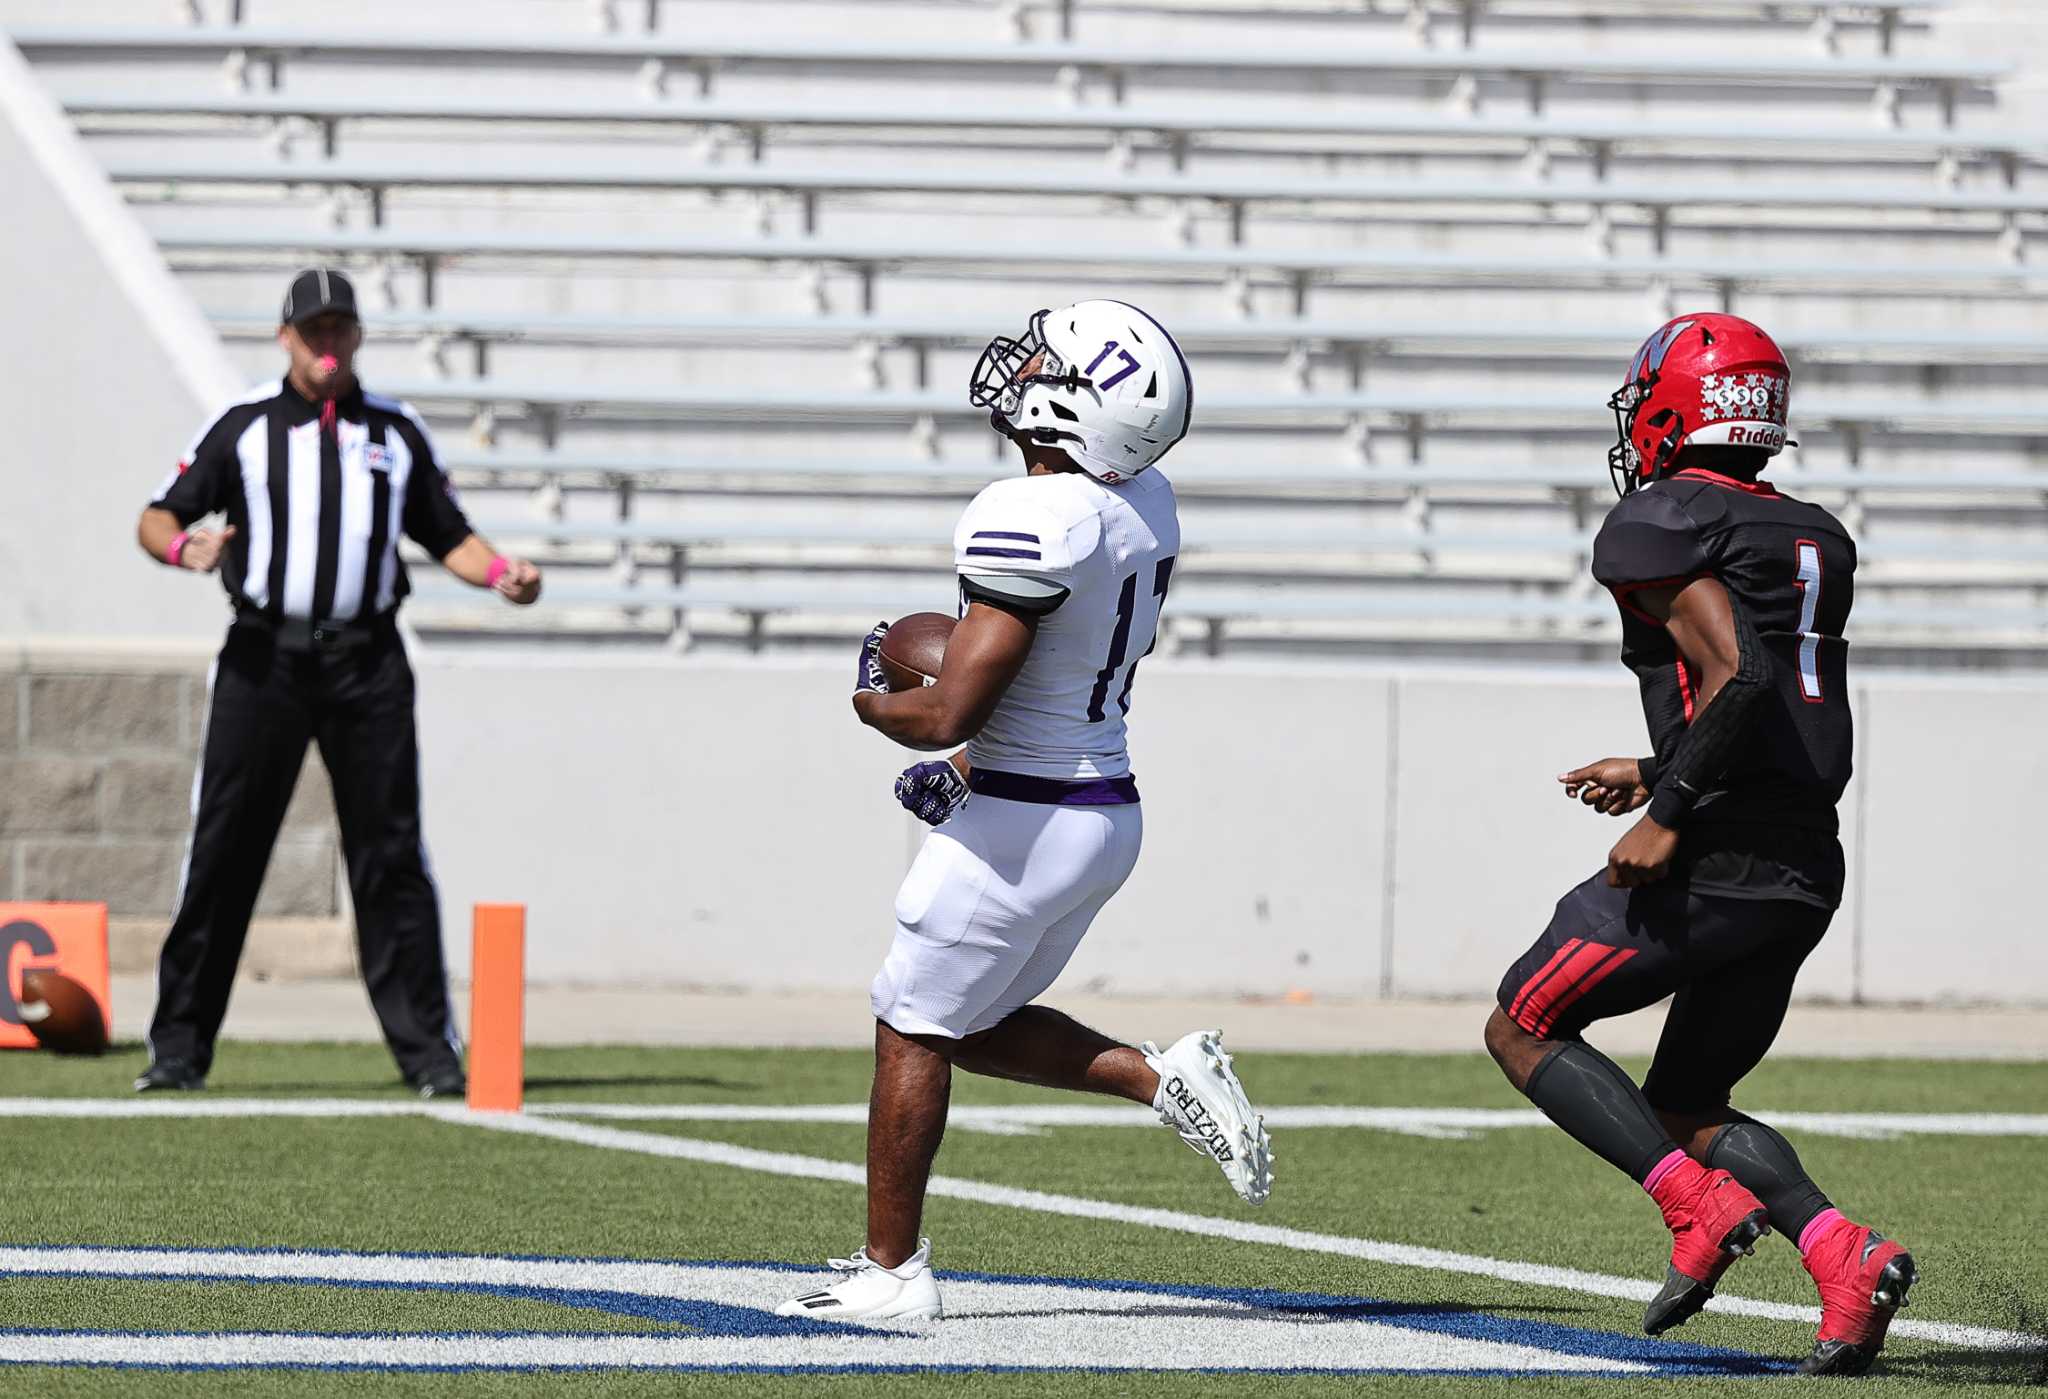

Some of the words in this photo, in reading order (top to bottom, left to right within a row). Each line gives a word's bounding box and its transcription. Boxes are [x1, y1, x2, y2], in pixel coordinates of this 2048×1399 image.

[1084, 340, 1141, 392] 17
[1086, 555, 1176, 723] 17
[1792, 538, 1824, 703] 1
[0, 920, 57, 1024] G
